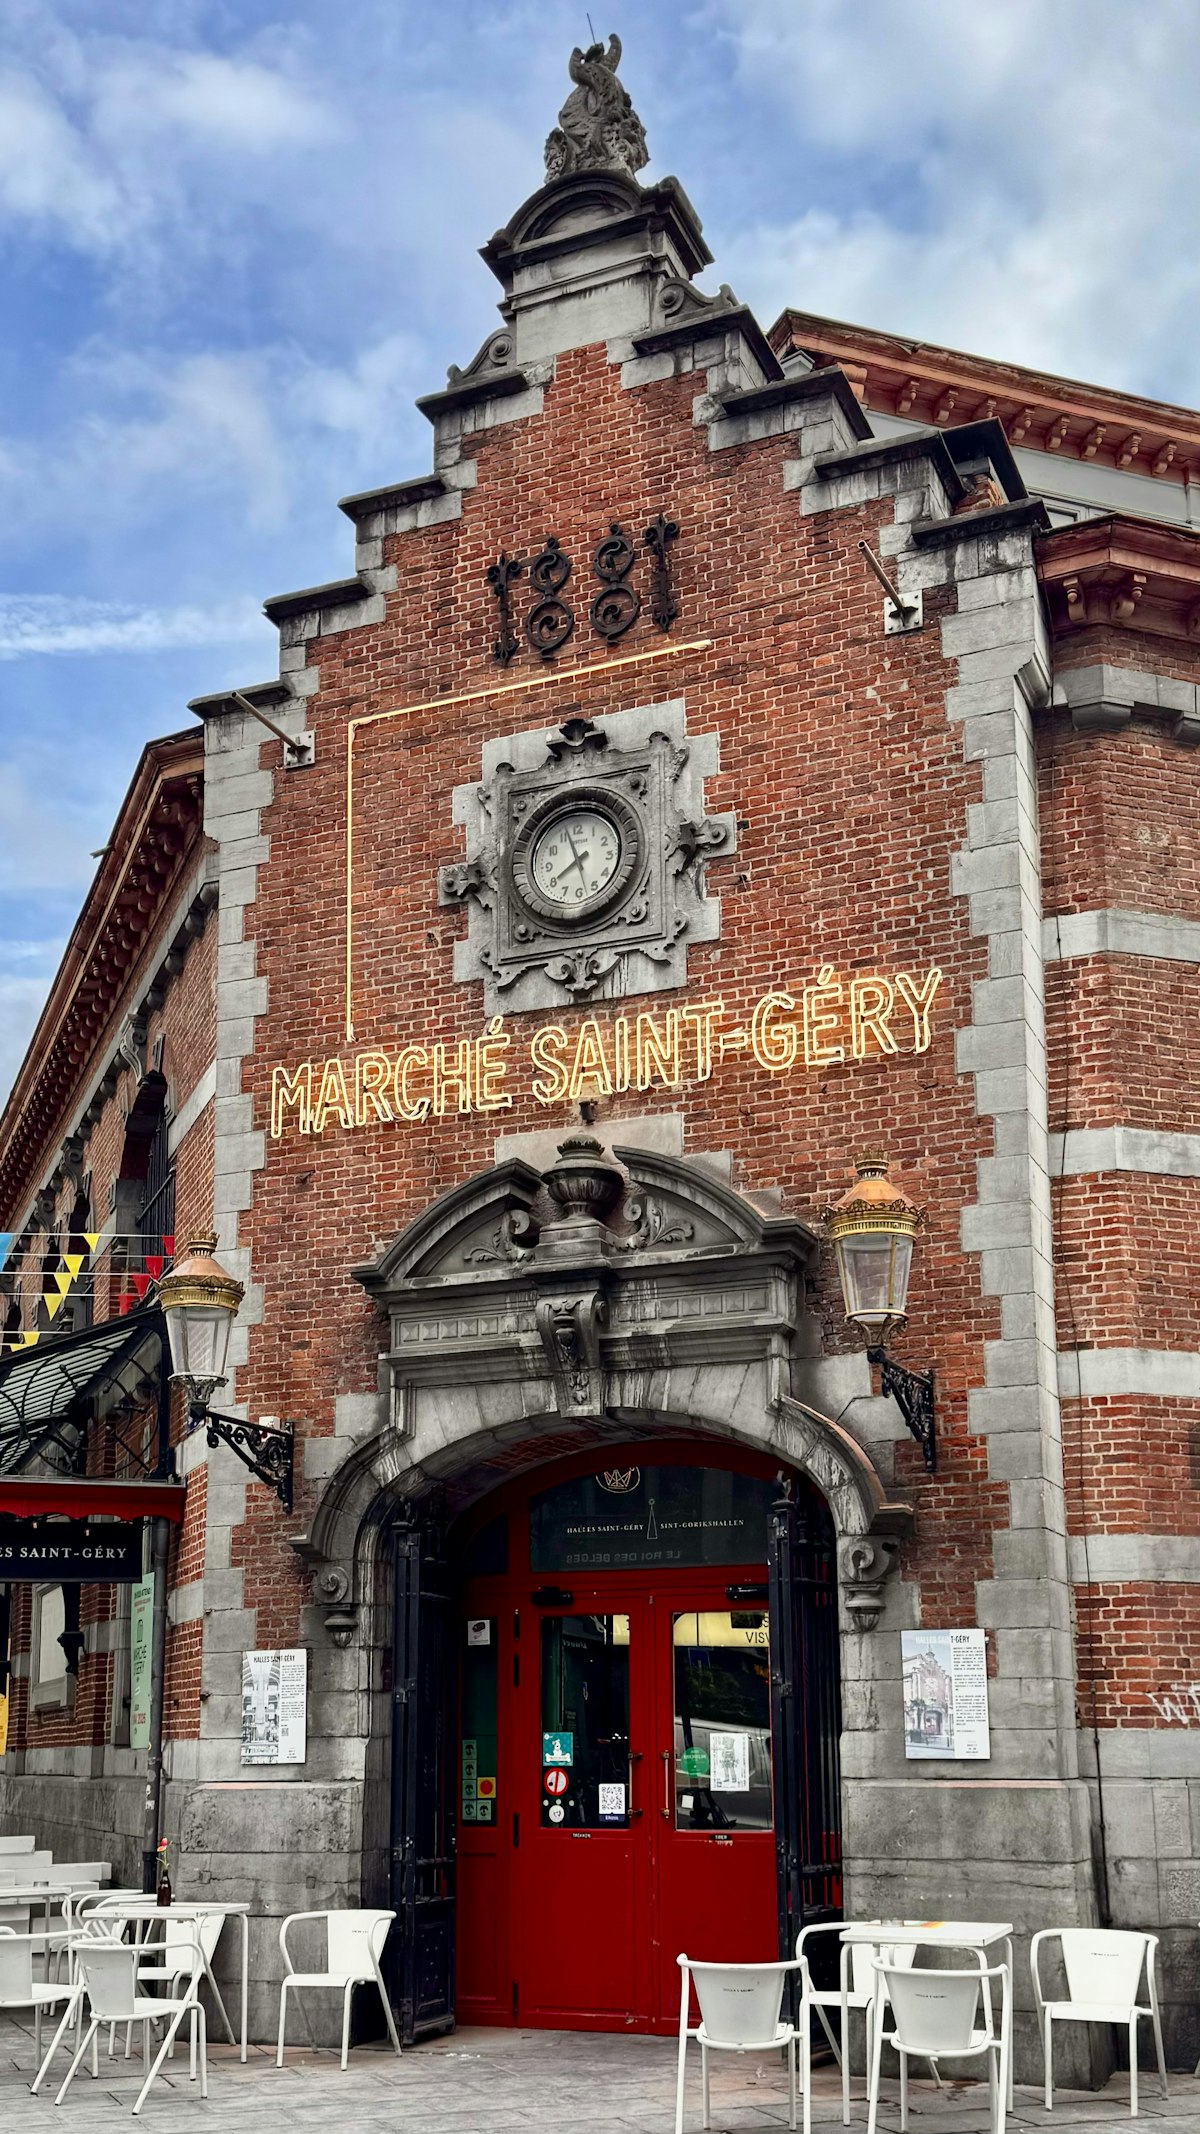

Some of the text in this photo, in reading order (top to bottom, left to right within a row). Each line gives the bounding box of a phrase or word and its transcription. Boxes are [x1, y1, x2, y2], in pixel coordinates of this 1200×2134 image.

[573, 825, 583, 835] 12
[560, 832, 567, 843] 11
[600, 836, 608, 847] 2
[549, 845, 558, 856] 10
[605, 850, 613, 860] 3
[545, 862, 553, 872] 9
[600, 867, 609, 877] 4
[549, 877, 557, 888] 8
[591, 881, 598, 891] 5
[561, 886, 569, 896] 7
[575, 888, 583, 898] 6
[271, 965, 942, 1138] MARCHÉ SAINT-GÉRY
[567, 1523, 644, 1534] HALLES SAINT-GÉRY
[660, 1519, 745, 1530] SINT-GORIKSHALLEN
[20, 1545, 127, 1559] SAINT-GÉRY
